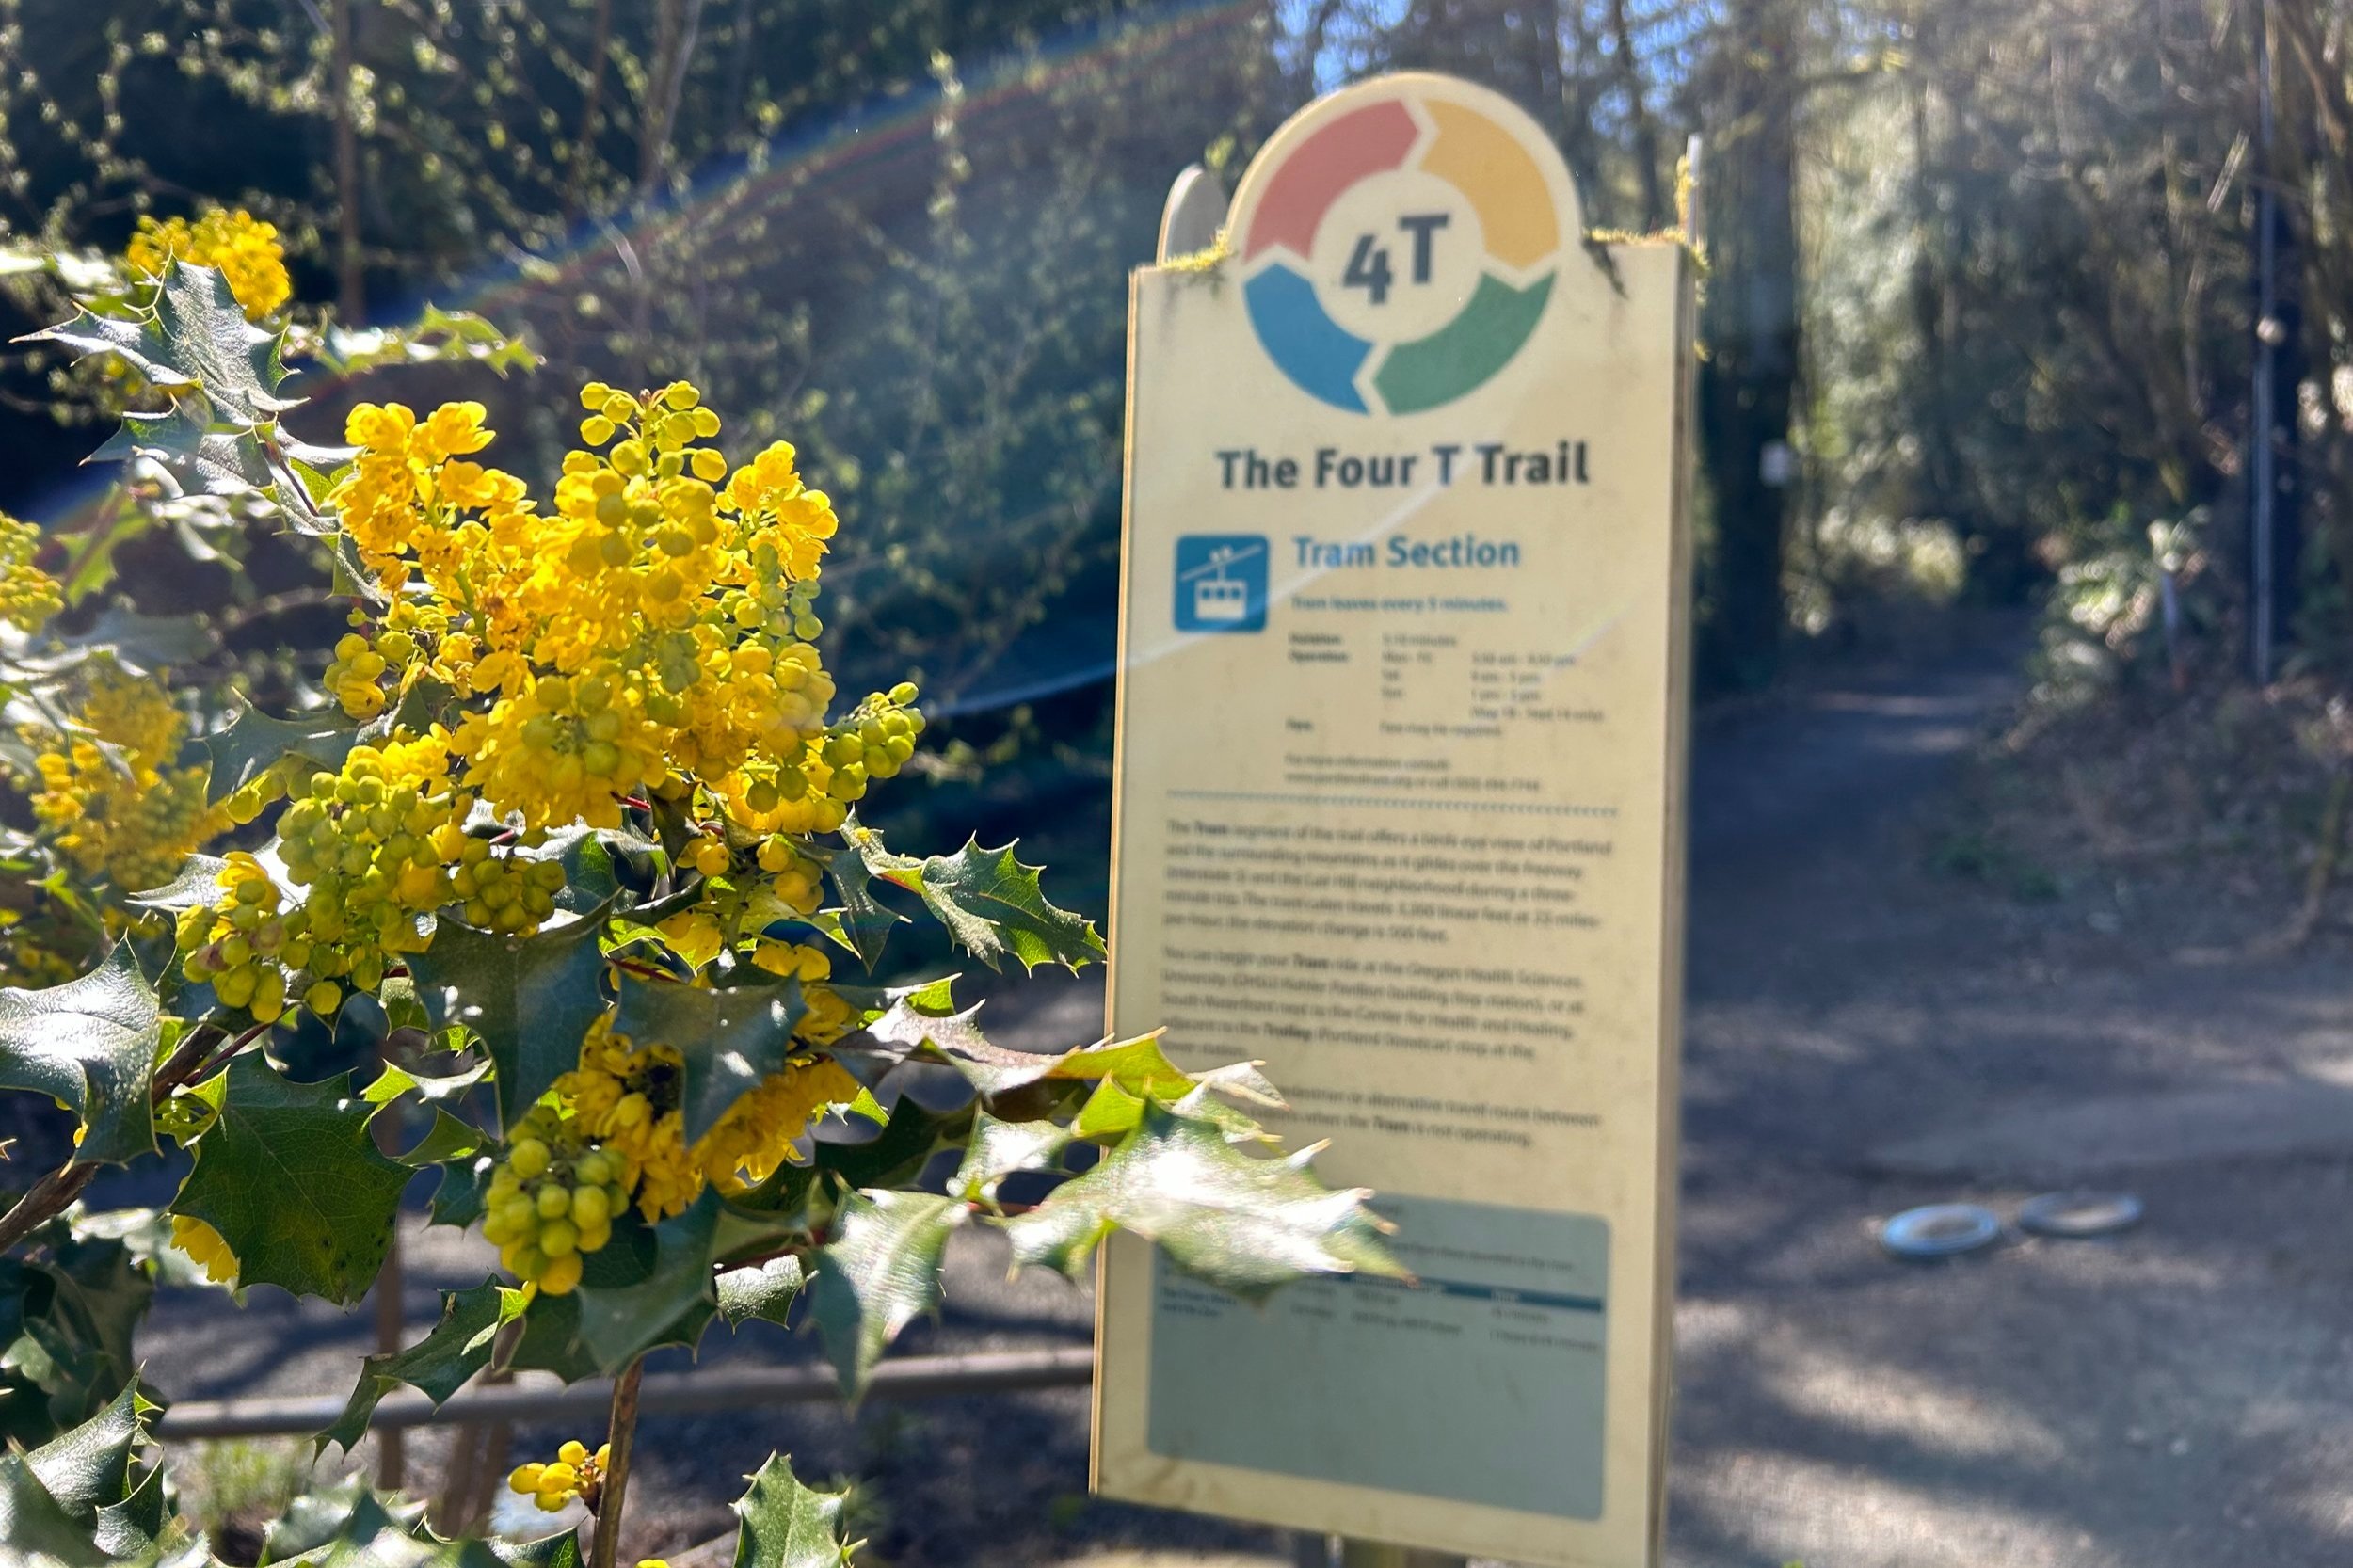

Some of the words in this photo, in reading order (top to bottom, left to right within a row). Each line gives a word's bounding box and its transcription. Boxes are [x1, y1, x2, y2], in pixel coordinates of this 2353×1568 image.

[1343, 213, 1449, 305] 4T
[1216, 448, 1298, 488] The
[1315, 447, 1417, 488] Four
[1433, 445, 1462, 485] T
[1475, 439, 1590, 485] Trail
[1292, 536, 1375, 567] Tram
[1386, 534, 1520, 567] Section
